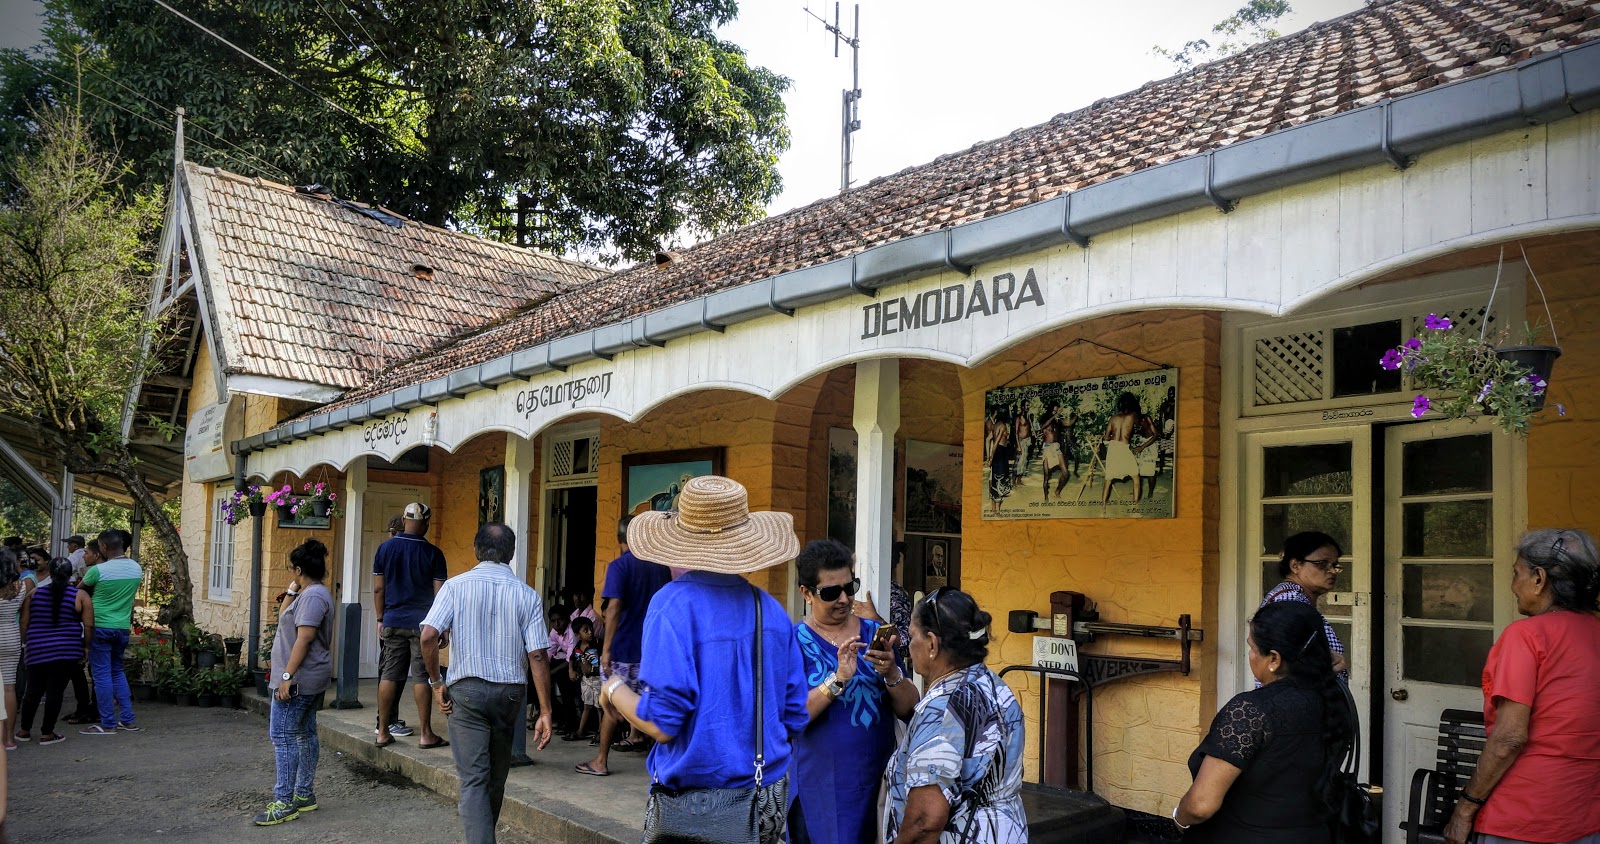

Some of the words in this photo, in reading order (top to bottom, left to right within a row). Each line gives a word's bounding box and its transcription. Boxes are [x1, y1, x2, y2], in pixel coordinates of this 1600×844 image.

[861, 267, 1045, 340] DEMODARA
[516, 371, 613, 419] தெமோதரை
[364, 412, 408, 450] දෙමෝදර
[1085, 658, 1140, 683] AVERY
